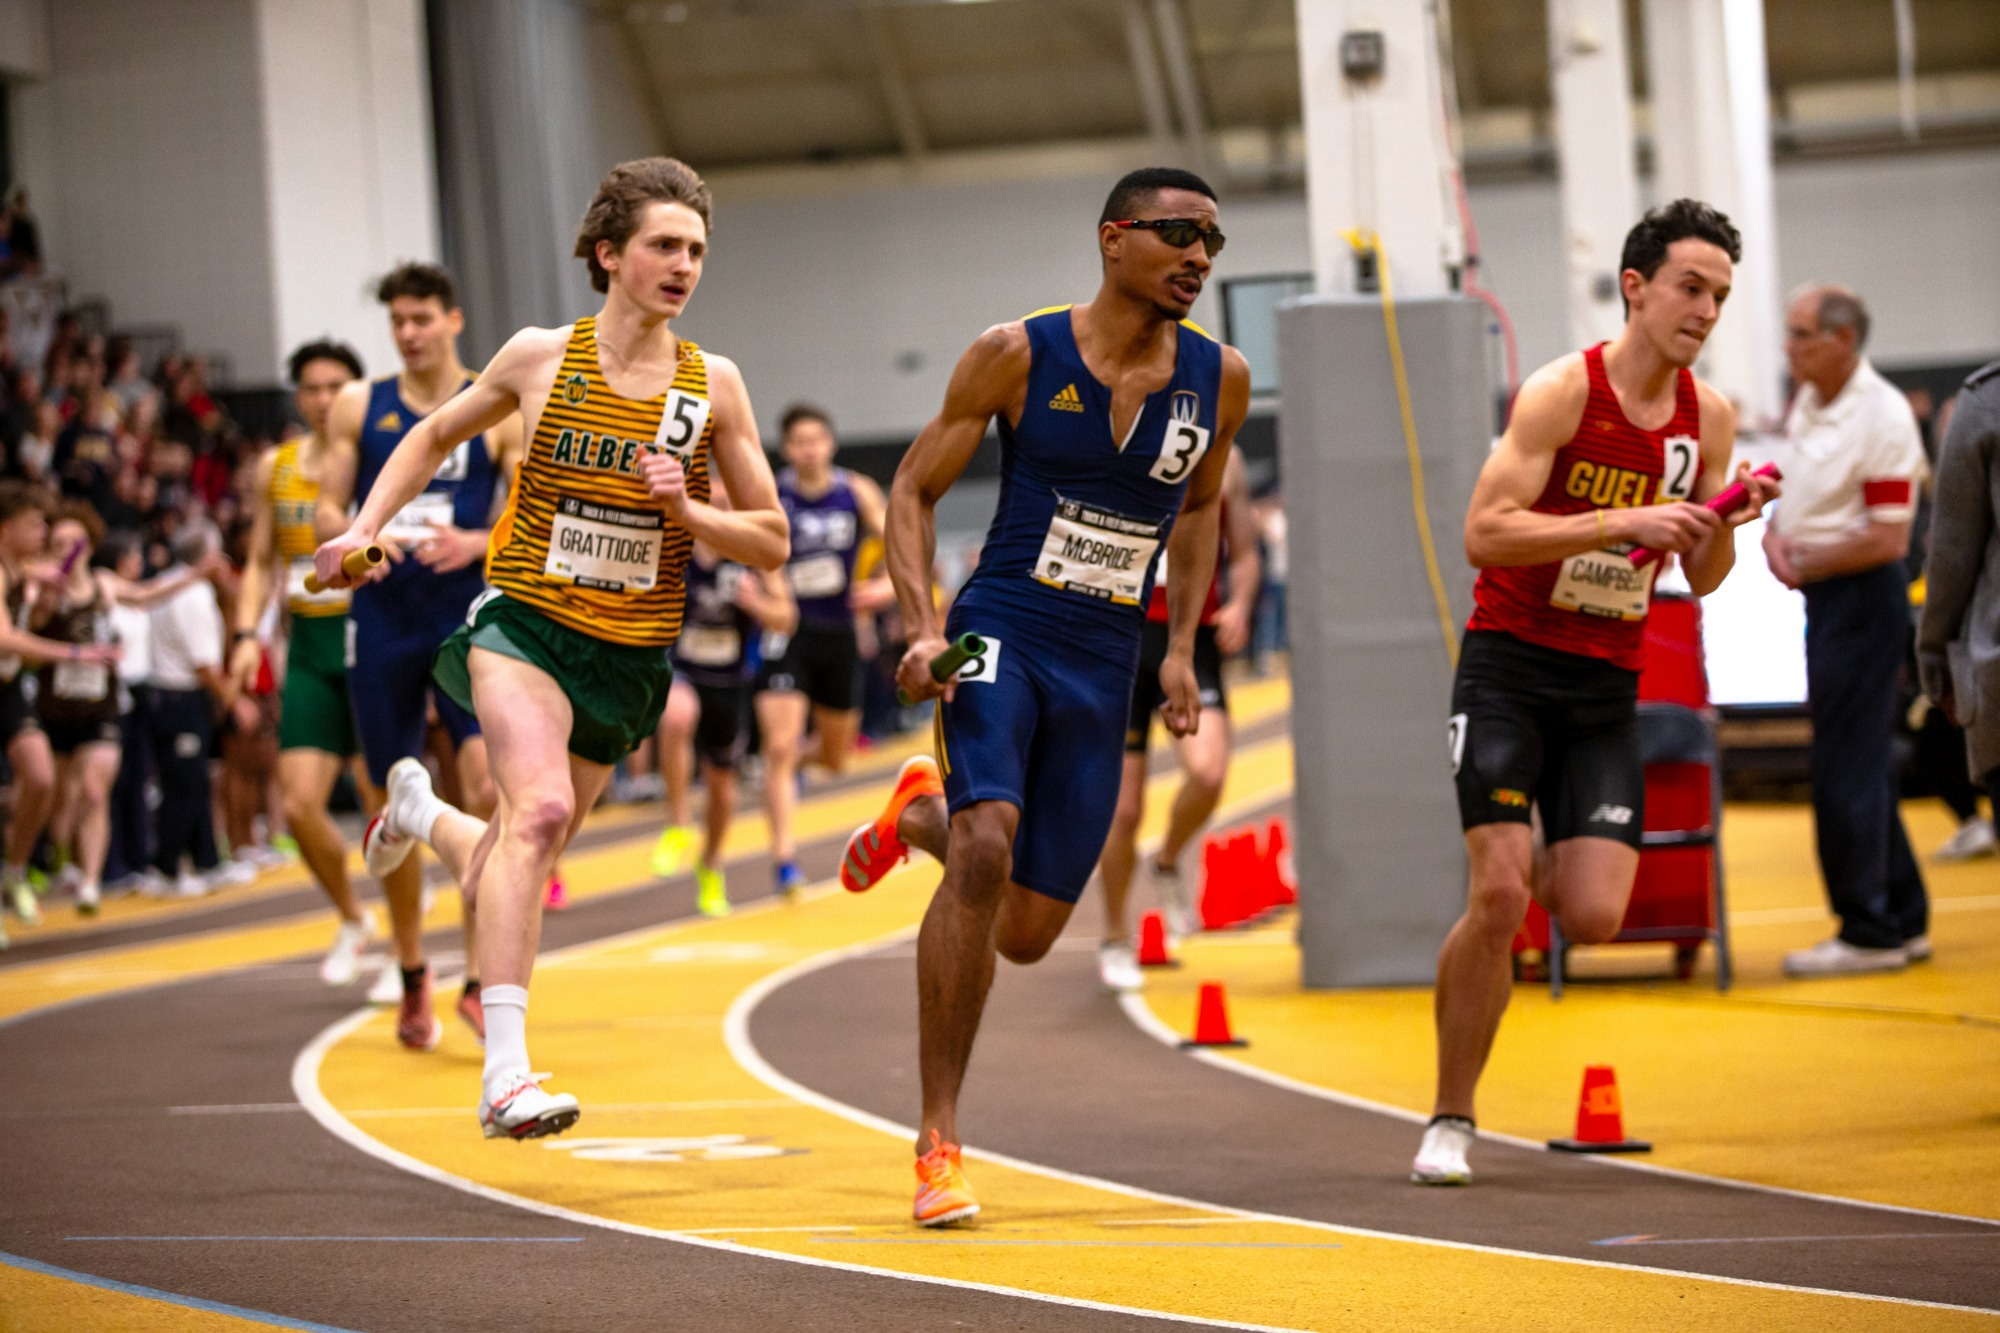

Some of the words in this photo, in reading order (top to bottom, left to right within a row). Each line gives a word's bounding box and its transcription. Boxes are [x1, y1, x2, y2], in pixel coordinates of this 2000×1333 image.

[666, 395, 699, 448] 5
[1048, 399, 1084, 413] adidas
[1160, 427, 1199, 480] 3
[1669, 443, 1691, 495] 2
[559, 527, 654, 565] GRATTIDGE
[1061, 533, 1139, 570] MCBRIDE
